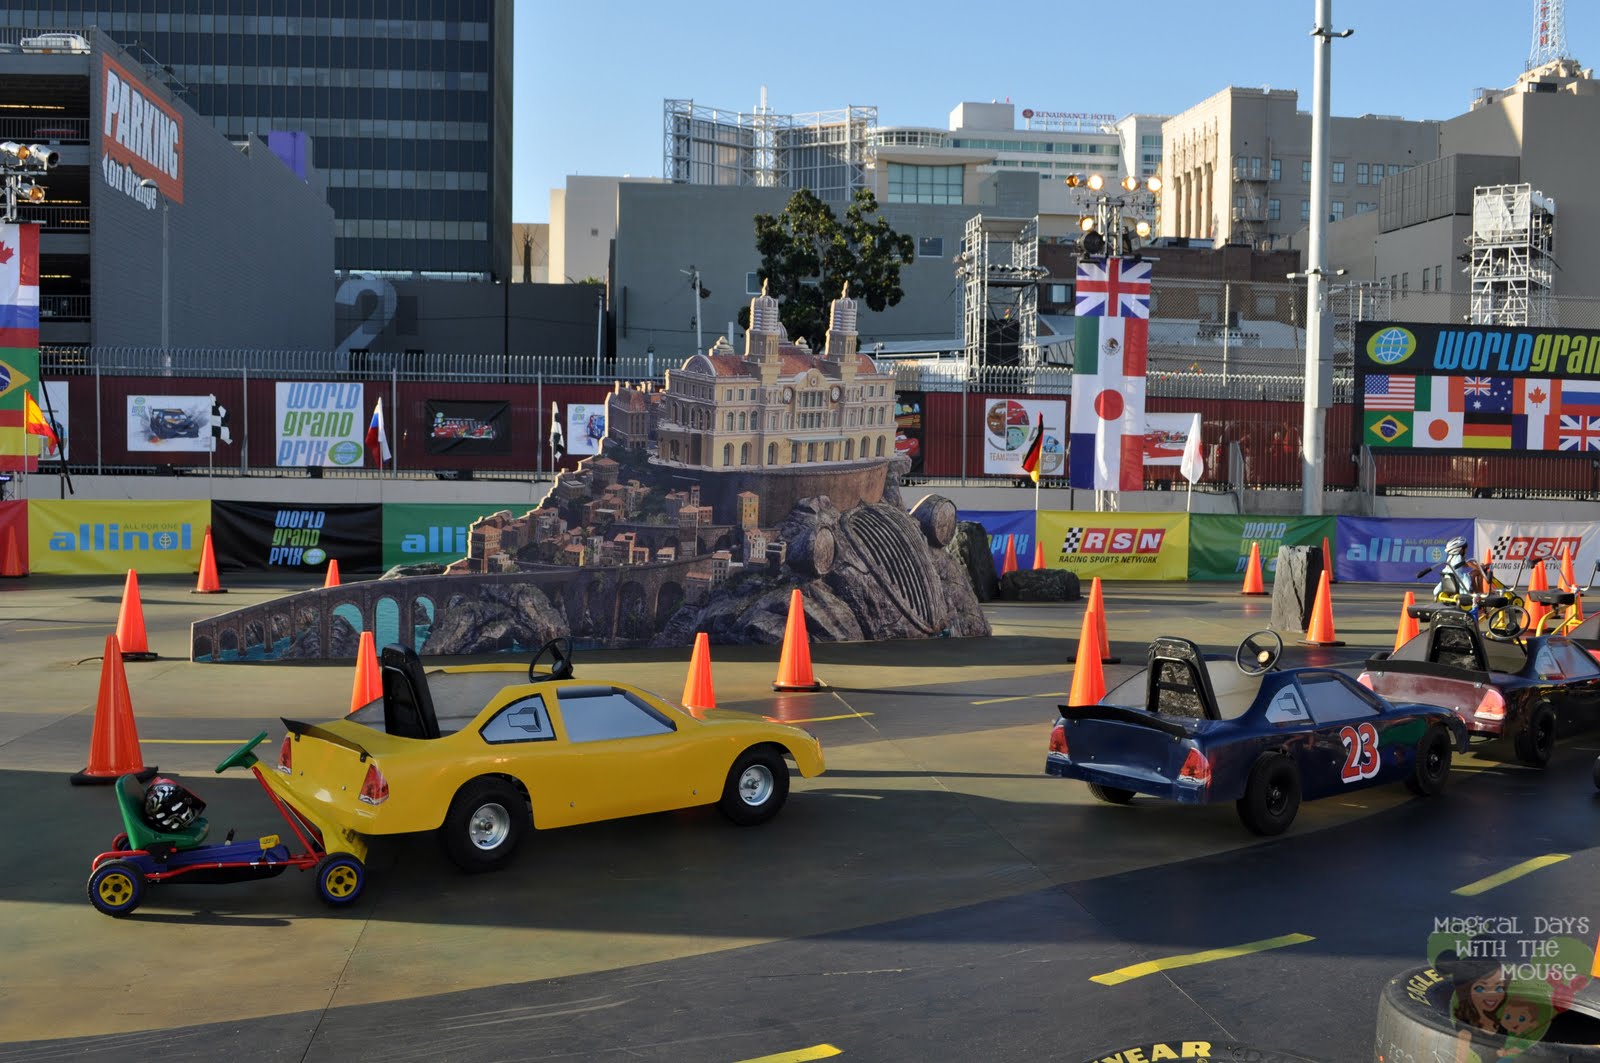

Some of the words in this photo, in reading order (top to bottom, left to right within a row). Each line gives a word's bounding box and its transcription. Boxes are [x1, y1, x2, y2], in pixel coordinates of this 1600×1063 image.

[104, 69, 179, 181] PARKING
[1036, 111, 1088, 119] RENAISSANCE
[1091, 113, 1117, 121] HOTEL
[108, 162, 123, 192] on
[1530, 333, 1600, 374] gran
[49, 523, 192, 551] allinol
[123, 522, 139, 530] ALL
[141, 522, 159, 530] FOR
[401, 526, 466, 553] alli
[1084, 533, 1160, 549] RSN
[1346, 538, 1447, 562] allino
[1120, 556, 1158, 564] NETWORK
[1339, 722, 1380, 784] 23
[1406, 969, 1444, 1006] EAGLE
[1093, 1041, 1212, 1063] YEAR
